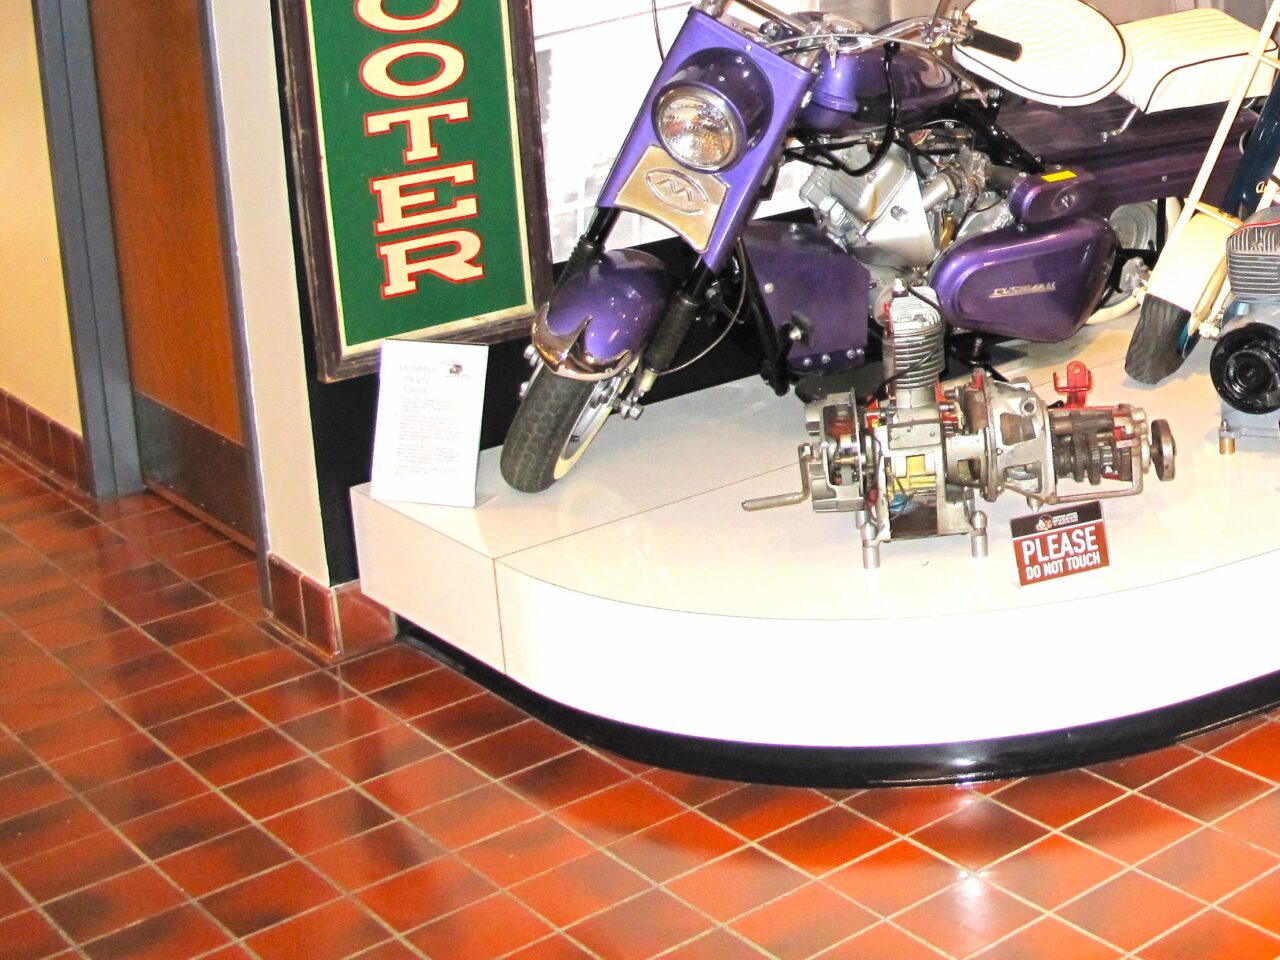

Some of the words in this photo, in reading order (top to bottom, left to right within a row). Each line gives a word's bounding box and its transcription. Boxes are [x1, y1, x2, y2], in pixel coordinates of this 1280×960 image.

[1022, 525, 1099, 566] PLEASE
[1025, 564, 1042, 580] DO
[1043, 559, 1064, 576] NOT
[1066, 551, 1101, 571] TOUCH
